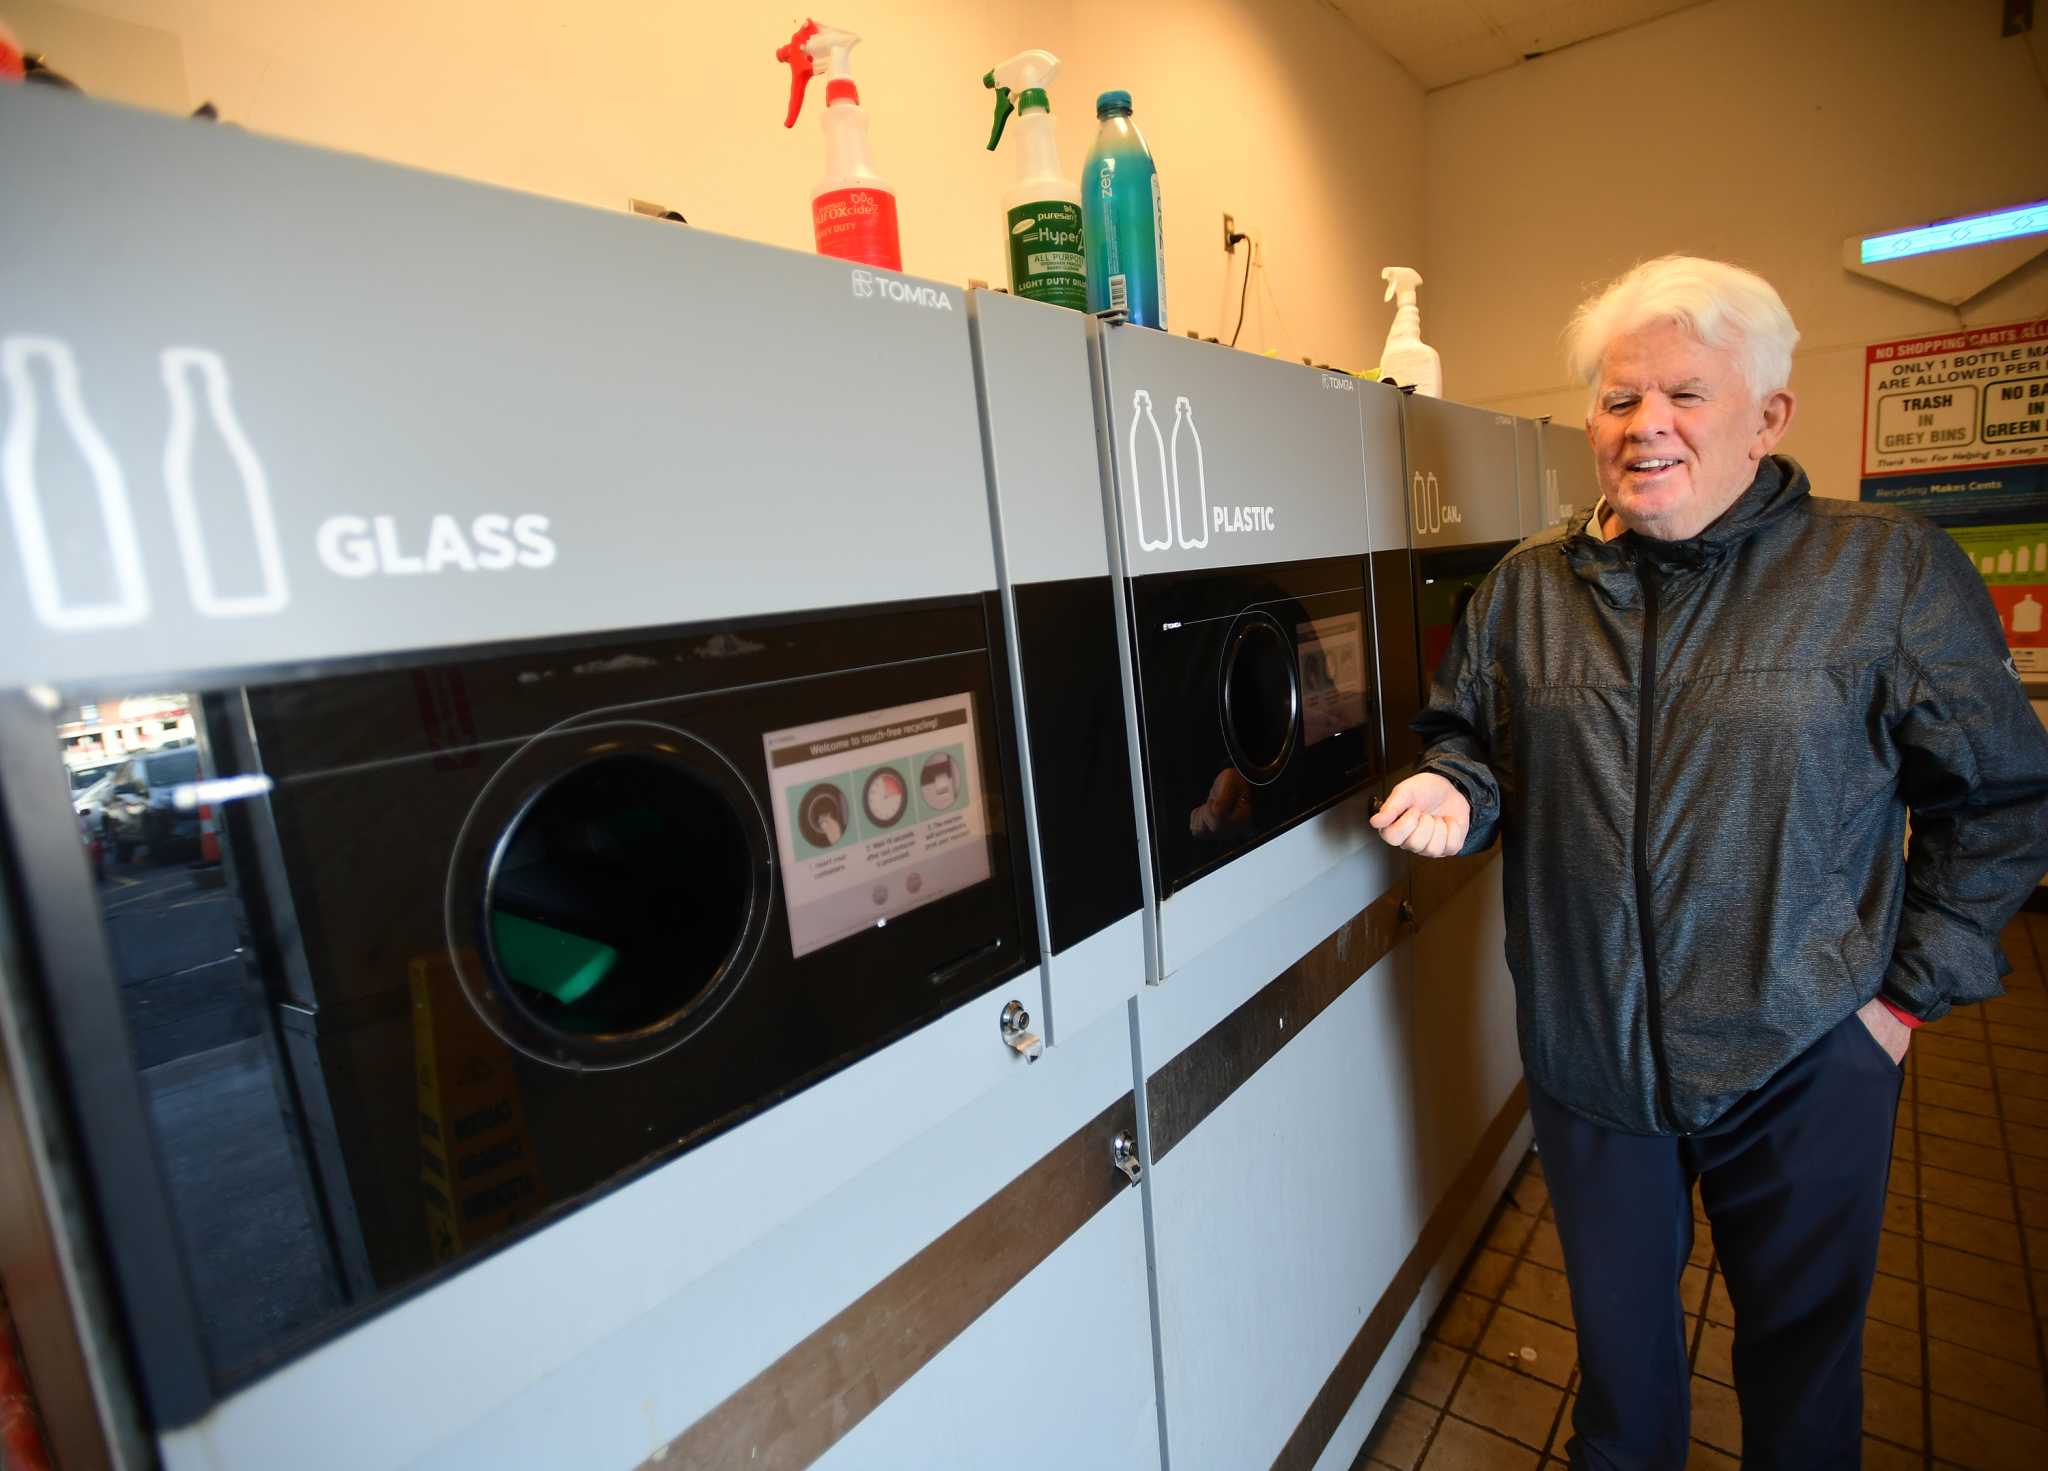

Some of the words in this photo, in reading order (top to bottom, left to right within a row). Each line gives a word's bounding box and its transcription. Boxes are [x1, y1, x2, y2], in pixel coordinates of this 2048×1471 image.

[1047, 278, 1070, 286] DUTY
[876, 276, 952, 311] TOMRA
[1876, 347, 1894, 359] NO
[1897, 337, 1966, 357] SHOPPING
[1968, 330, 2017, 345] CARTS
[1893, 361, 1934, 376] ONLY
[1941, 360, 1947, 369] 1
[1954, 348, 2022, 368] BOTTLE
[1878, 378, 1911, 391] ARE
[1916, 366, 2000, 386] ALLOWED
[2005, 361, 2039, 375] PER
[2002, 386, 2023, 400] NO
[1903, 395, 1953, 412] TRASH
[2028, 401, 2045, 415] IN
[1918, 414, 1934, 427] IN
[1986, 420, 2040, 437] GREEN
[1885, 432, 1925, 448] GREY
[1930, 427, 1967, 443] BINS
[1930, 483, 1967, 494] Makes
[1968, 480, 2003, 491] Cents
[1212, 506, 1276, 532] PLASTIC
[316, 514, 557, 578] GLASS
[809, 738, 850, 755] Welcome
[851, 736, 860, 746] to
